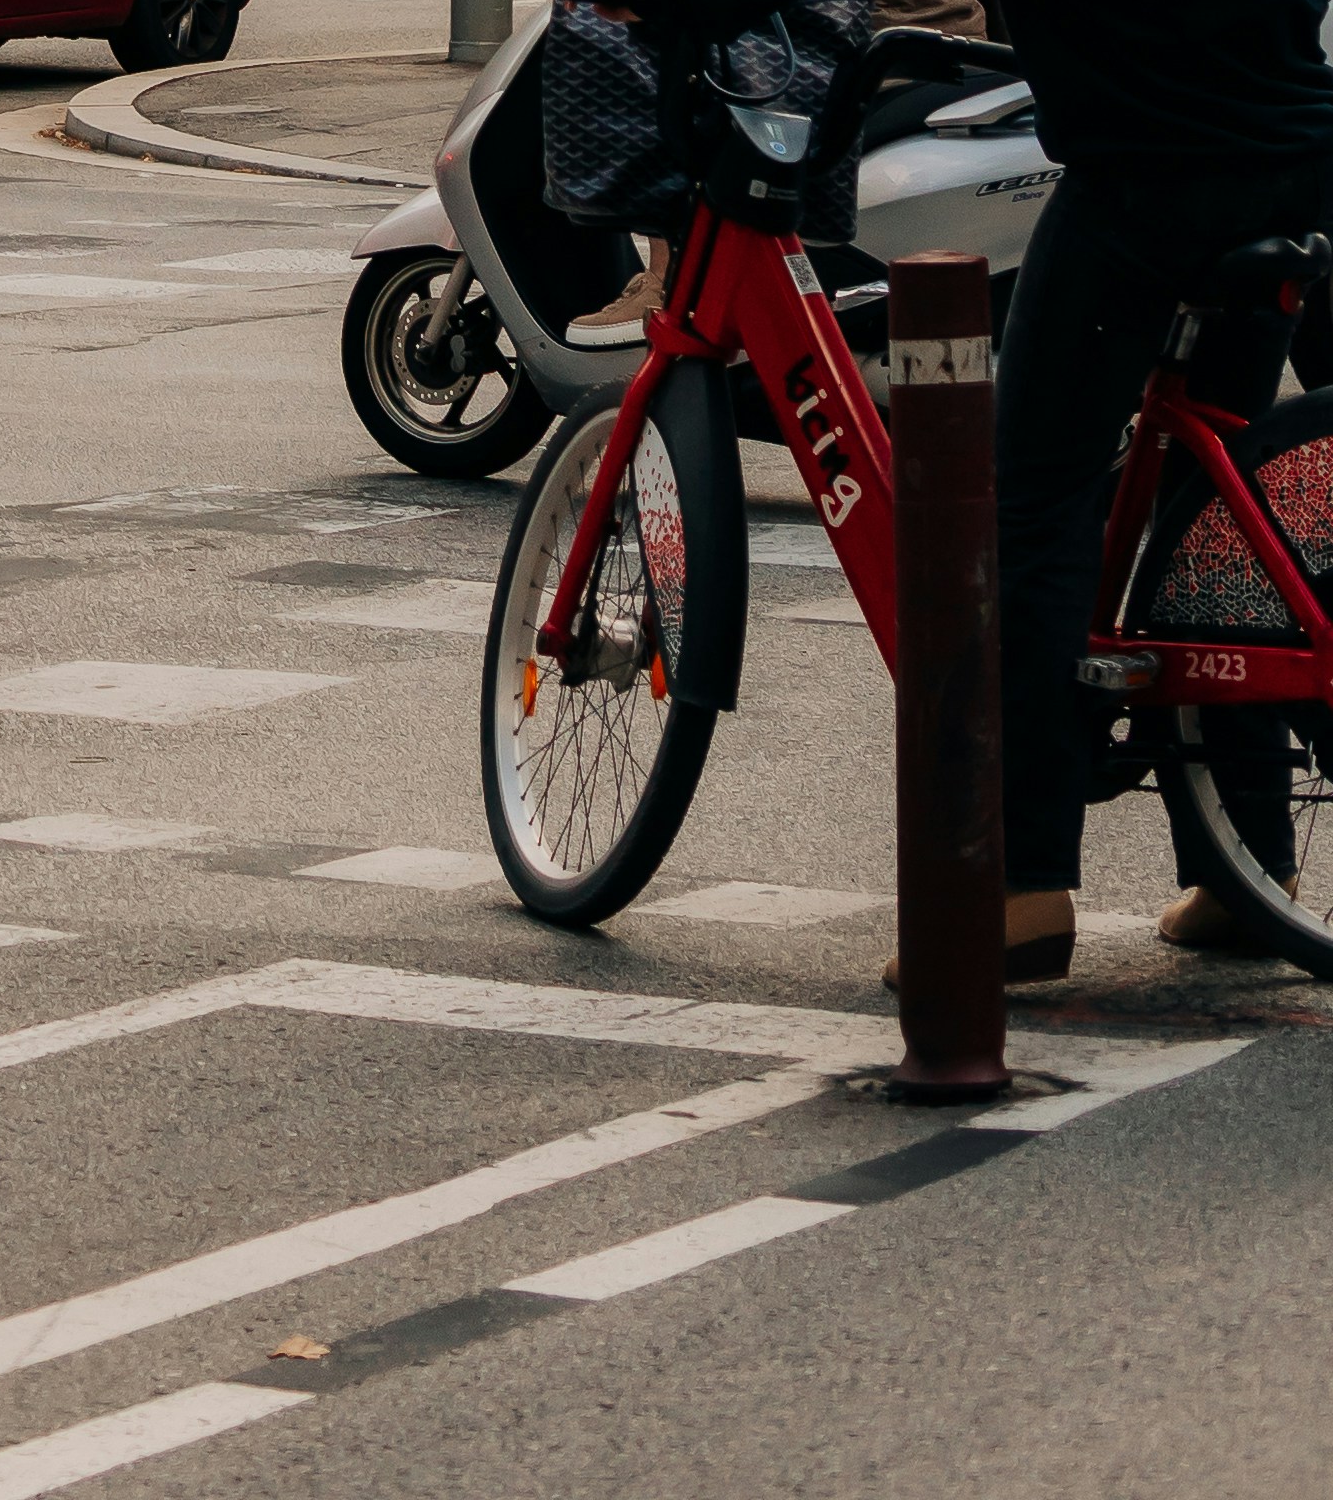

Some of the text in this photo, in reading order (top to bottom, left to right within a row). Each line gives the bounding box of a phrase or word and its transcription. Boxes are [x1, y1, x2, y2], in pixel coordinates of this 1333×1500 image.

[978, 170, 1065, 195] LEAD
[785, 353, 862, 528] bicing
[1185, 651, 1247, 682] 2423
